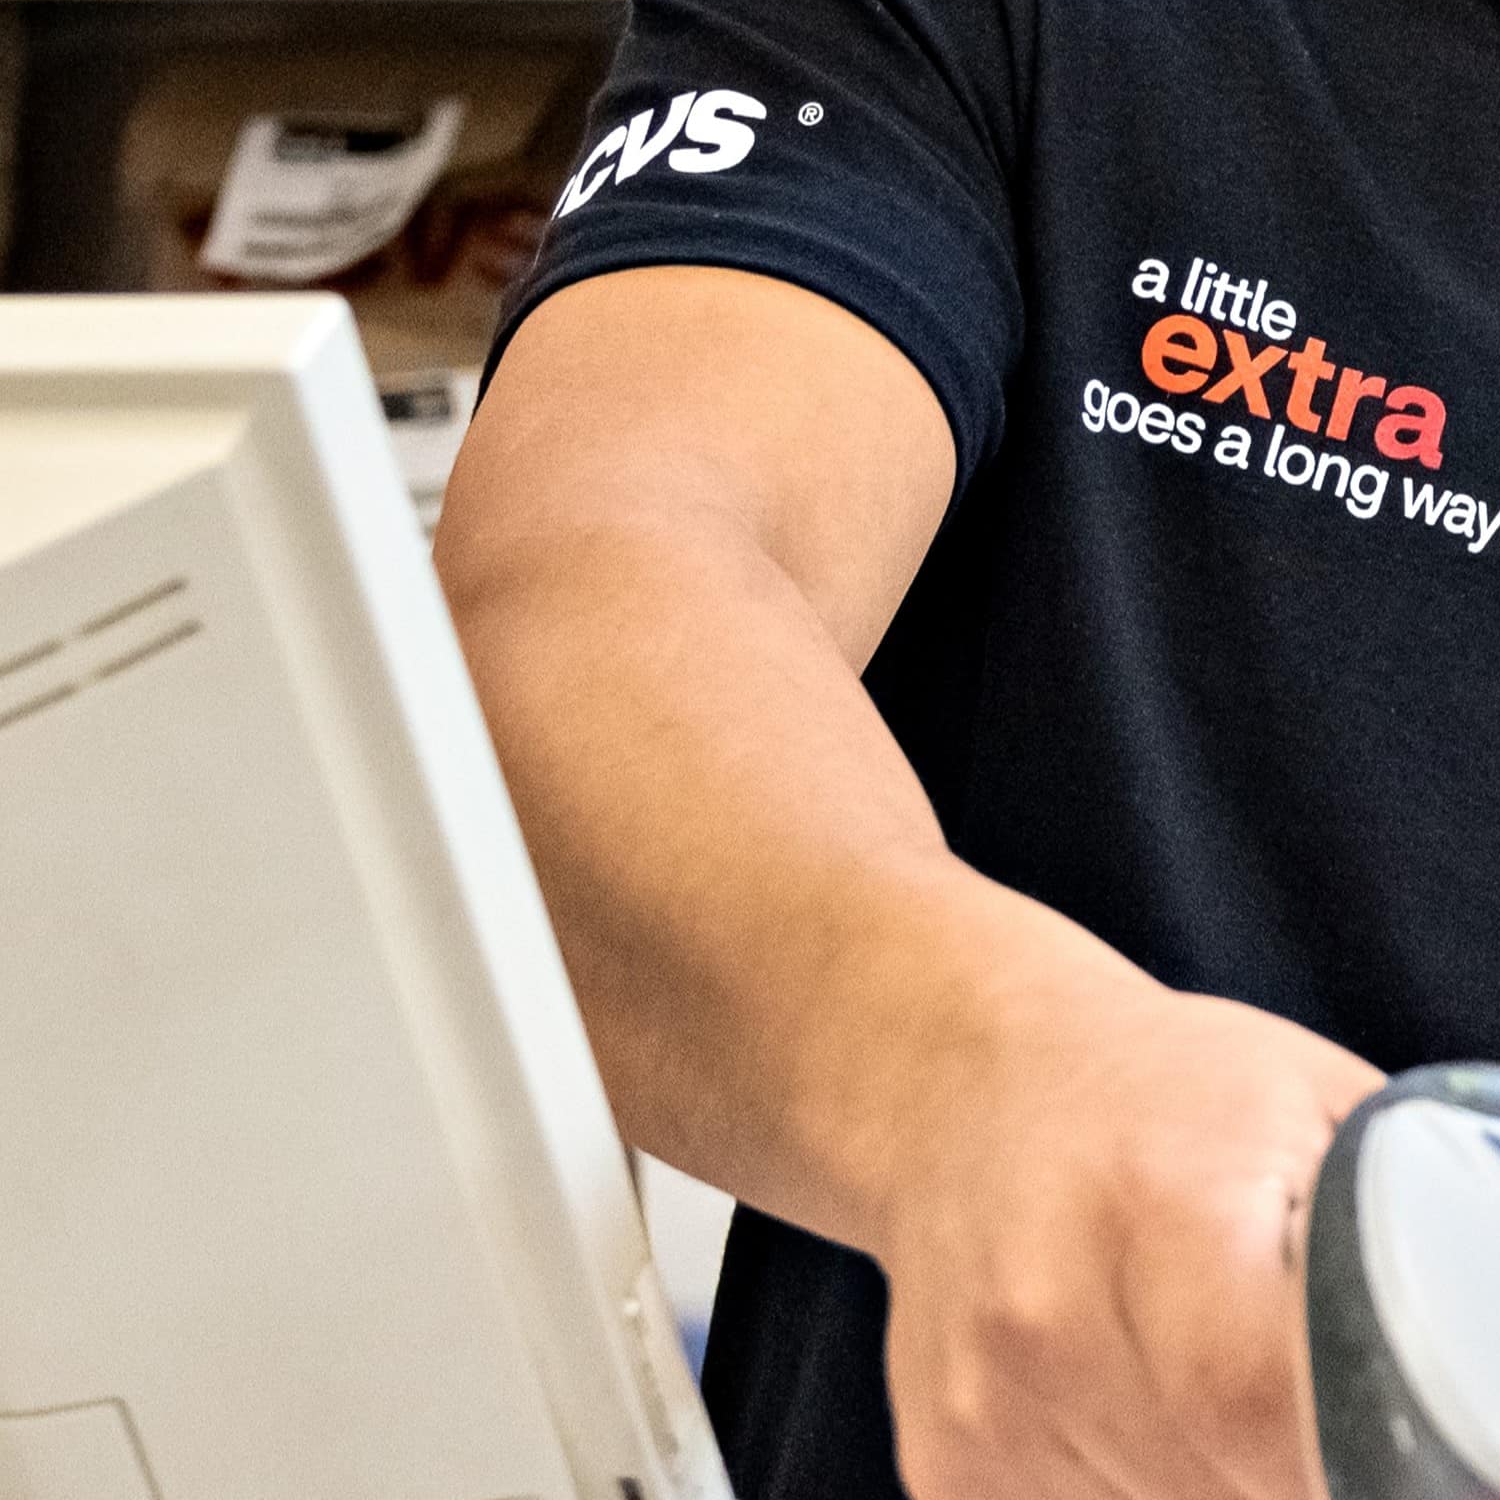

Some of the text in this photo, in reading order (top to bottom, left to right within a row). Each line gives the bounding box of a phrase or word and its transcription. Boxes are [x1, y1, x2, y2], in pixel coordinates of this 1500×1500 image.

[558, 89, 767, 218] CVS
[1132, 257, 1297, 340] a little
[1082, 379, 1206, 454] goes
[1213, 425, 1251, 470] a
[1264, 425, 1389, 519] long
[1142, 314, 1447, 470] extra
